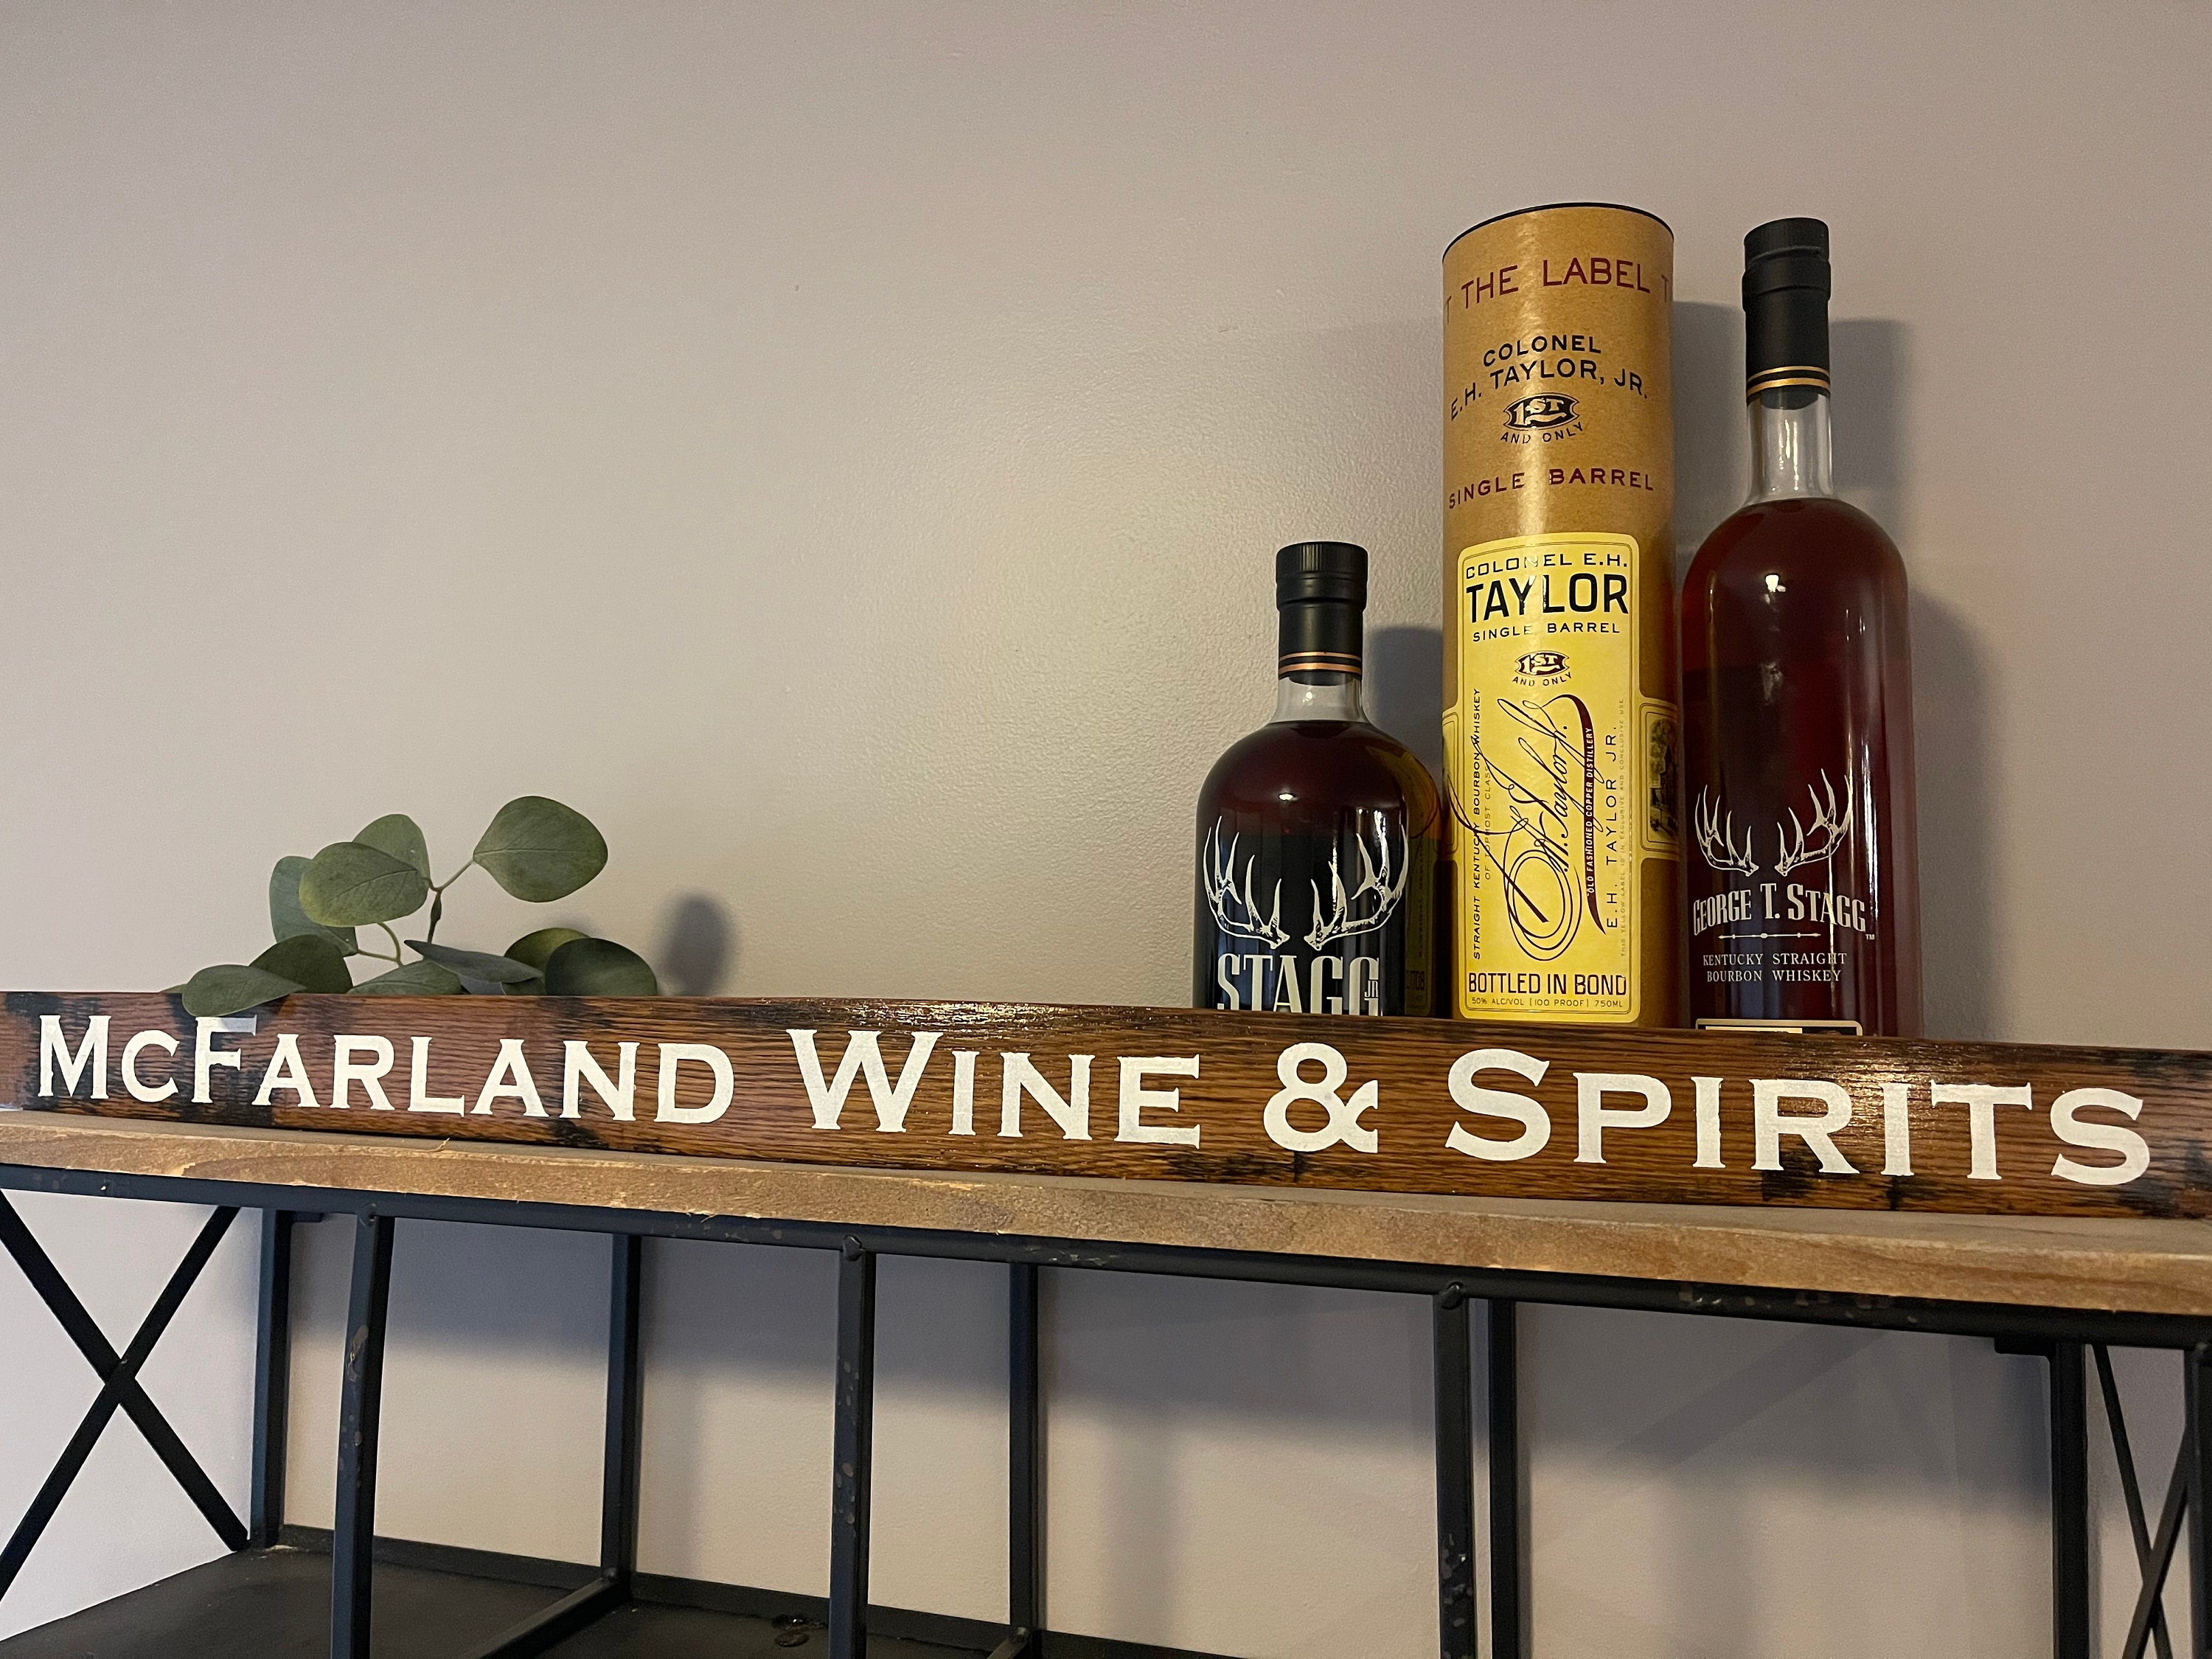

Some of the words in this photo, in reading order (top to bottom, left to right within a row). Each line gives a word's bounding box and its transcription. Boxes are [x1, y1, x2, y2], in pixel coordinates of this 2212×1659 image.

[1461, 265, 1517, 309] THE
[1543, 257, 1650, 293] LABEL
[1484, 335, 1601, 366] COLONEL
[1451, 383, 1482, 422] E.H.
[1490, 358, 1605, 390] TAYLOR,
[1614, 369, 1647, 399] JR.
[1500, 431, 1531, 444] AND
[1543, 422, 1583, 442] ONLY
[1449, 473, 1525, 509] SINGLE
[1549, 468, 1654, 491] BARREL
[1466, 554, 1572, 579] COLONEL
[1585, 553, 1627, 567] E.H.
[1466, 573, 1629, 623] TAYLOR
[1473, 625, 1533, 641] SINGLE
[1548, 622, 1620, 633] BARREL
[1512, 676, 1535, 686] AND
[1543, 672, 1572, 686] ONLY
[1585, 727, 1594, 777] DISTILLERY
[1605, 726, 1617, 762] JR.
[1585, 782, 1594, 817] COPPER
[1606, 779, 1618, 866] TAYLOR
[1585, 821, 1594, 872] FASHIONED
[1485, 867, 1491, 880] OF
[1606, 883, 1618, 928] E.H.
[1693, 889, 1752, 936] GEORGE
[1760, 883, 1781, 919] T.
[1787, 883, 1866, 933] STAGG
[1703, 953, 1764, 966] KENTUCKY
[1772, 953, 1847, 965] STRAIGHT
[1707, 970, 1762, 982] BOURBON
[1772, 970, 1842, 981] WHISKEY
[1217, 953, 1380, 1017] STAGG
[1469, 973, 1540, 993] BOTTLED
[1548, 974, 1567, 995] IN
[1574, 974, 1627, 995] BOND
[1263, 1042, 1379, 1154] &
